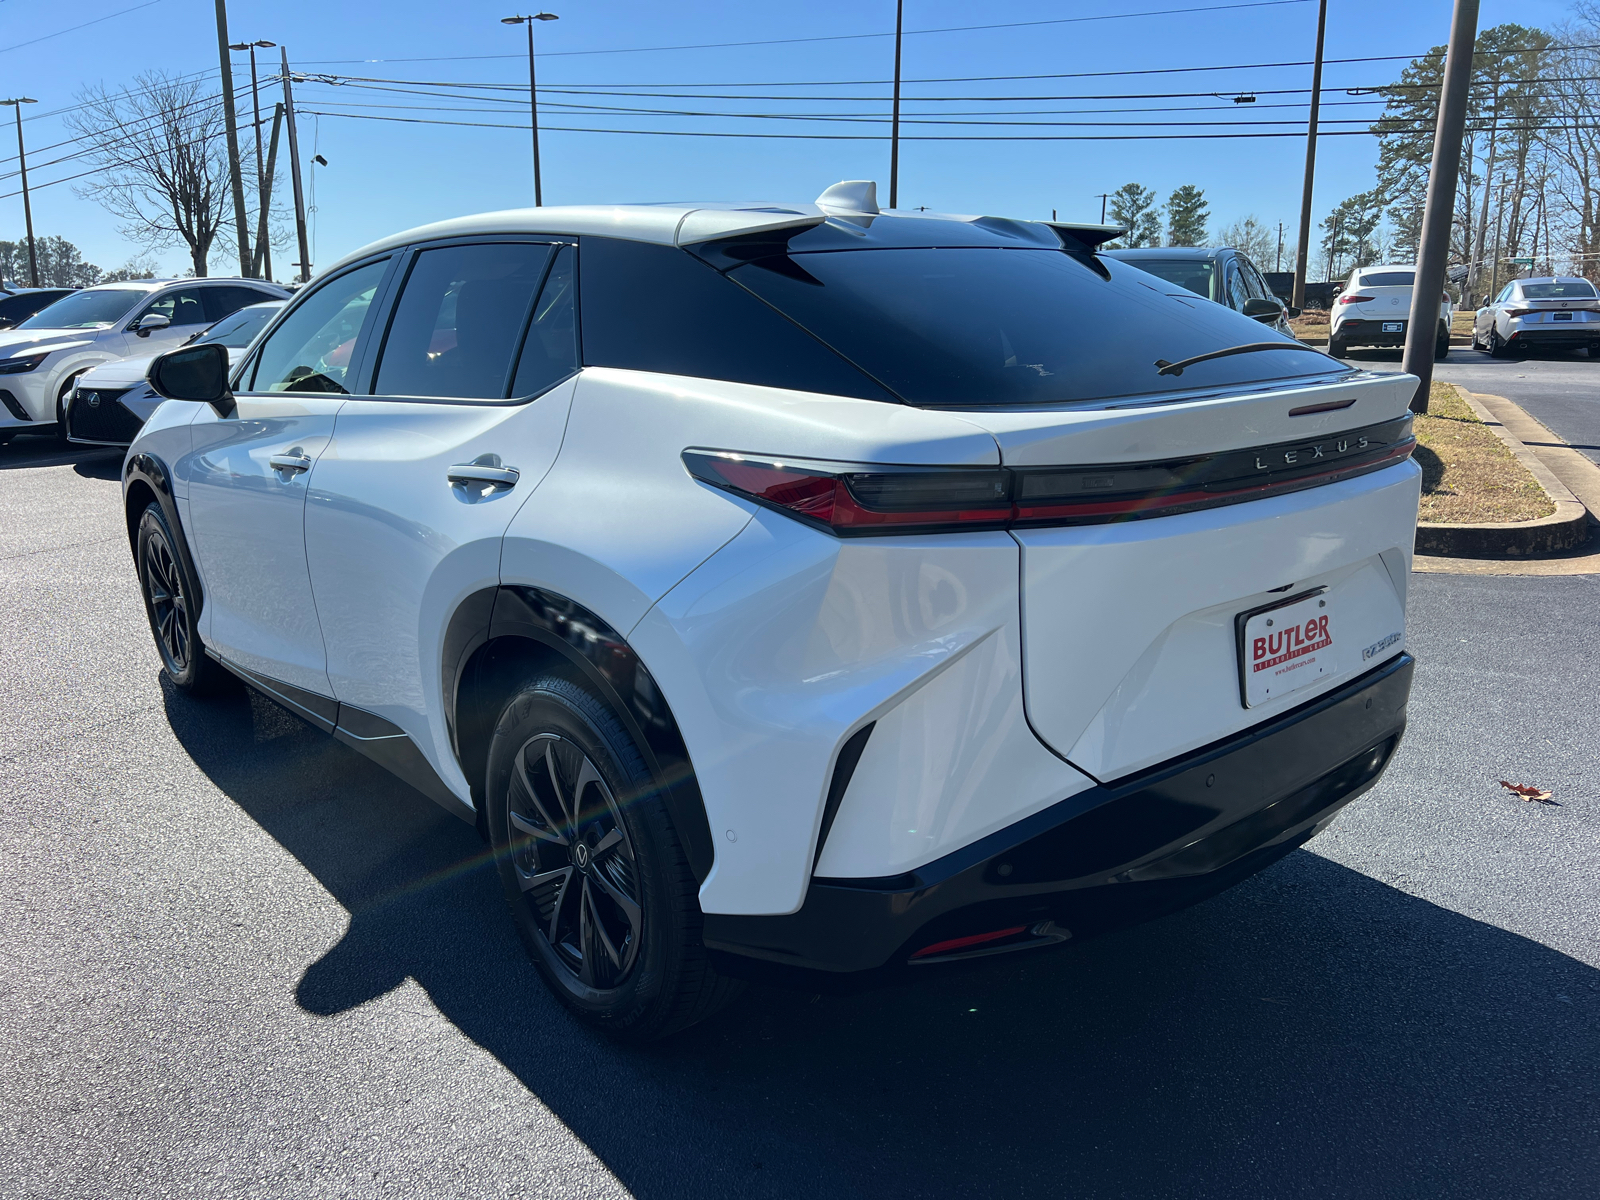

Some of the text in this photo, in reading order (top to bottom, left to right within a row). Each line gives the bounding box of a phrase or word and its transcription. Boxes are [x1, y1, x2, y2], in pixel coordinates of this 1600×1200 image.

[1255, 436, 1368, 469] LEXUS
[1254, 638, 1331, 672] AUTOMOTIVE GROUP
[1274, 657, 1316, 676] www.butlercars.com
